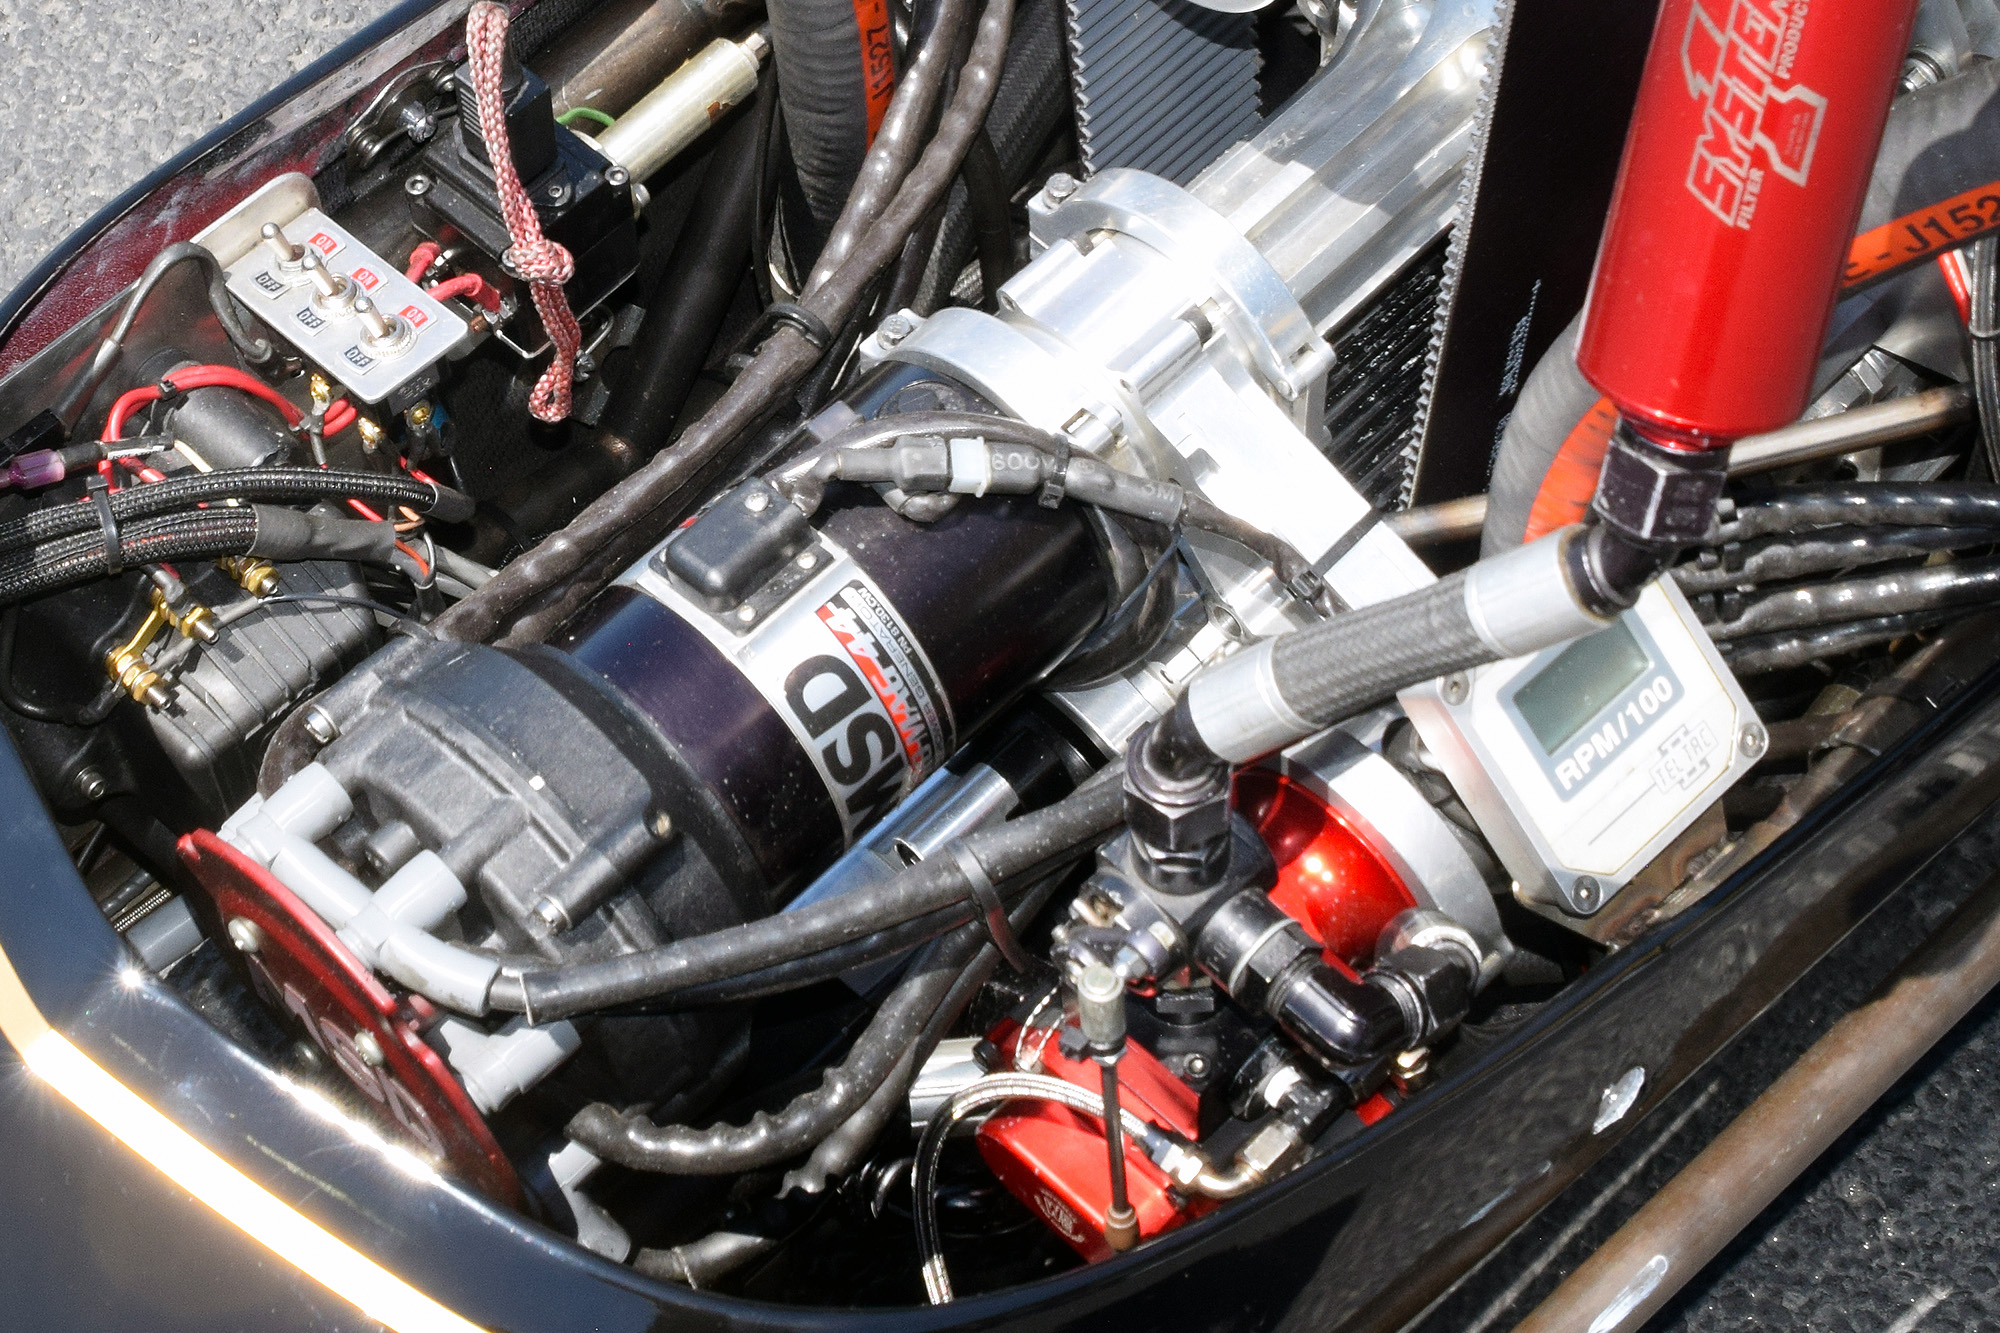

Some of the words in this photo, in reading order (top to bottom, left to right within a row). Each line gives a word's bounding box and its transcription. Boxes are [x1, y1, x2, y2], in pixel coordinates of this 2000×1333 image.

[1736, 167, 1765, 231] FILTER
[1776, 0, 1810, 80] PRODUC
[256, 275, 281, 292] OFF
[297, 312, 322, 329] OFF
[346, 349, 371, 368] OFF
[825, 606, 880, 660] 44
[857, 586, 901, 637] 8130.CW
[851, 593, 926, 700] GENERATO
[896, 635, 914, 655] PN
[784, 654, 903, 831] MSD
[1554, 675, 1673, 791] RPM/100
[1655, 755, 1685, 787] TEL
